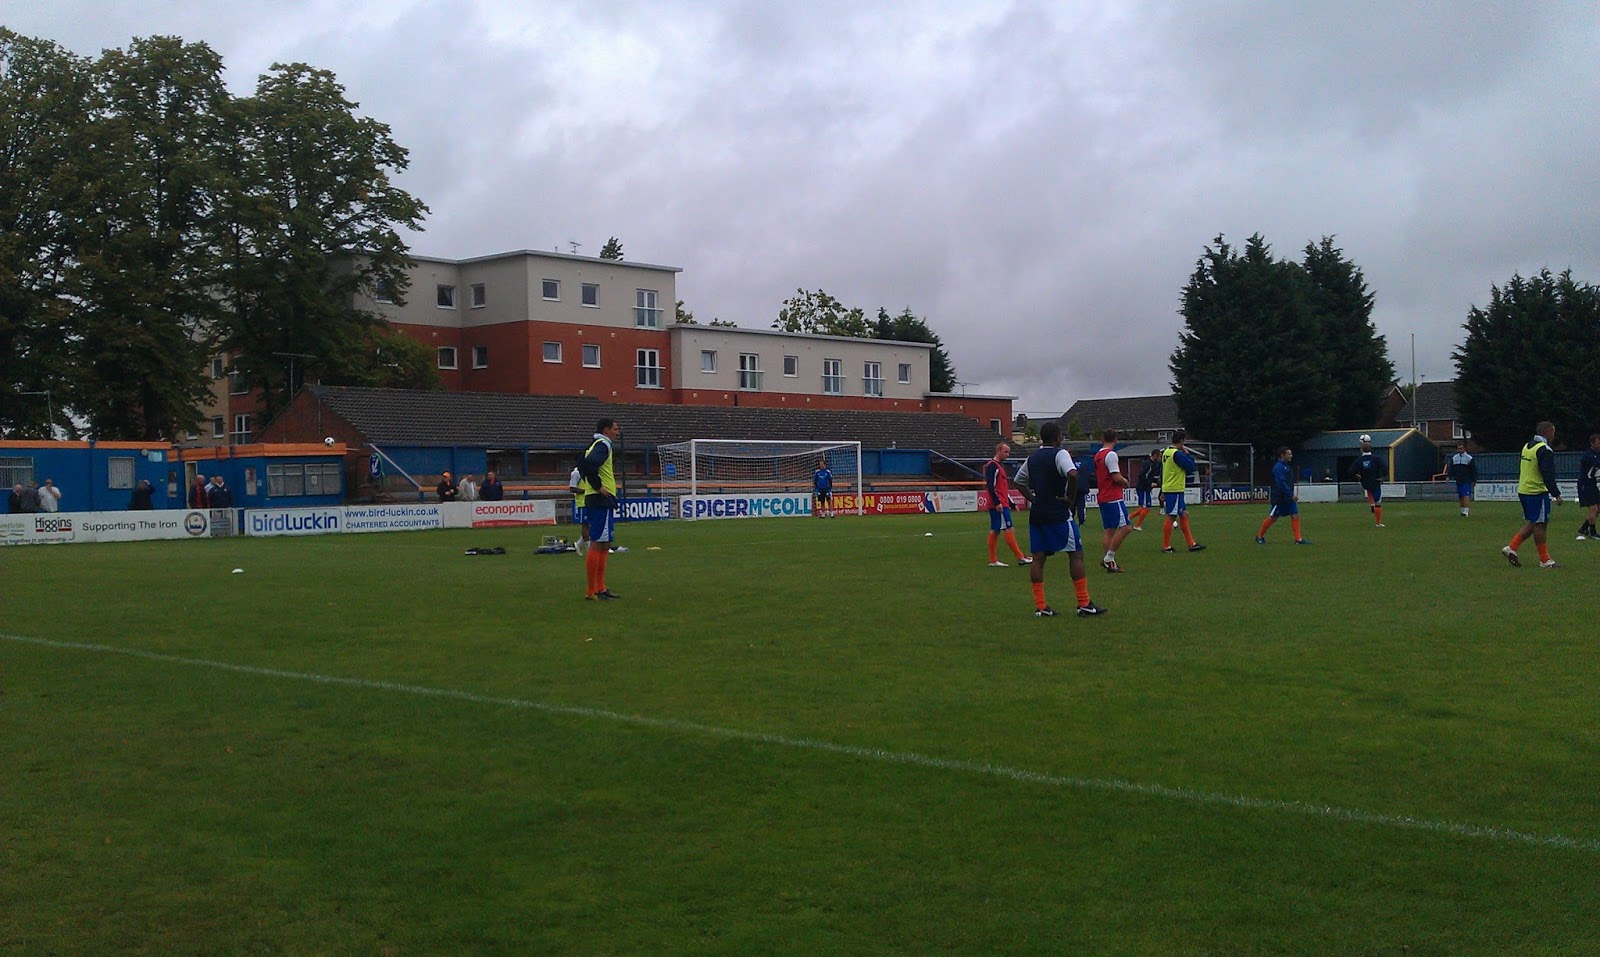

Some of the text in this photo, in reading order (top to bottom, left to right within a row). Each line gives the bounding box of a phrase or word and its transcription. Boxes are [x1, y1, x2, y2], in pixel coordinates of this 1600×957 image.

[1213, 488, 1268, 501] Nationwide
[345, 507, 439, 518] www.bird-luckin.co.uk
[475, 503, 534, 515] econoprint
[622, 501, 670, 519] SQUARE
[35, 517, 72, 532] Higgins
[82, 520, 178, 533] Supporting The Iron
[346, 519, 440, 529] CHARTERED ACCOUNTANTS
